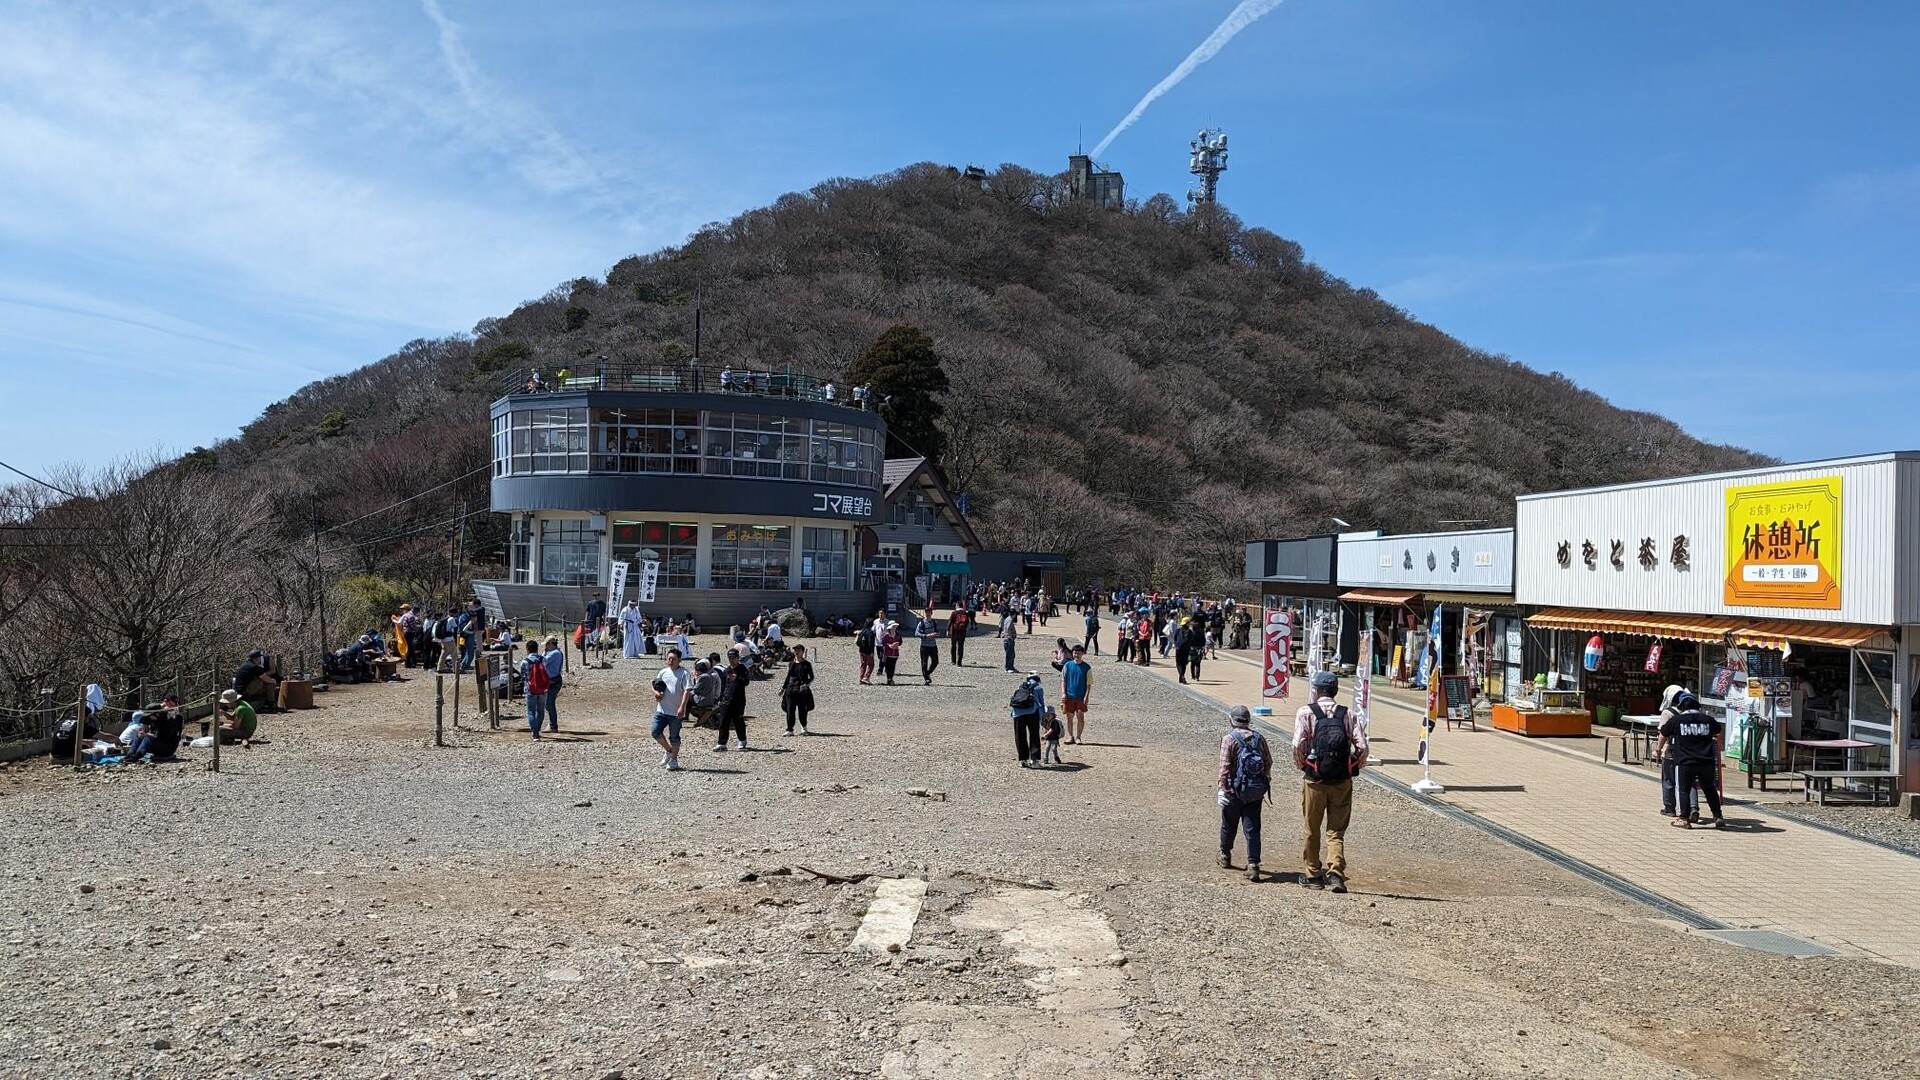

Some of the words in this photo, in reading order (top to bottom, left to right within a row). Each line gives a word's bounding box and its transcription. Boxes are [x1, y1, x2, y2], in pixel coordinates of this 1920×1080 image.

[813, 493, 873, 516] コマ展望台
[1749, 500, 1813, 516] お食事・おみやげ
[727, 528, 777, 542] おみやげ
[1742, 519, 1821, 560] 休憩所
[1557, 534, 1688, 568] めをと茶屋
[1263, 612, 1291, 697] ラーメン
